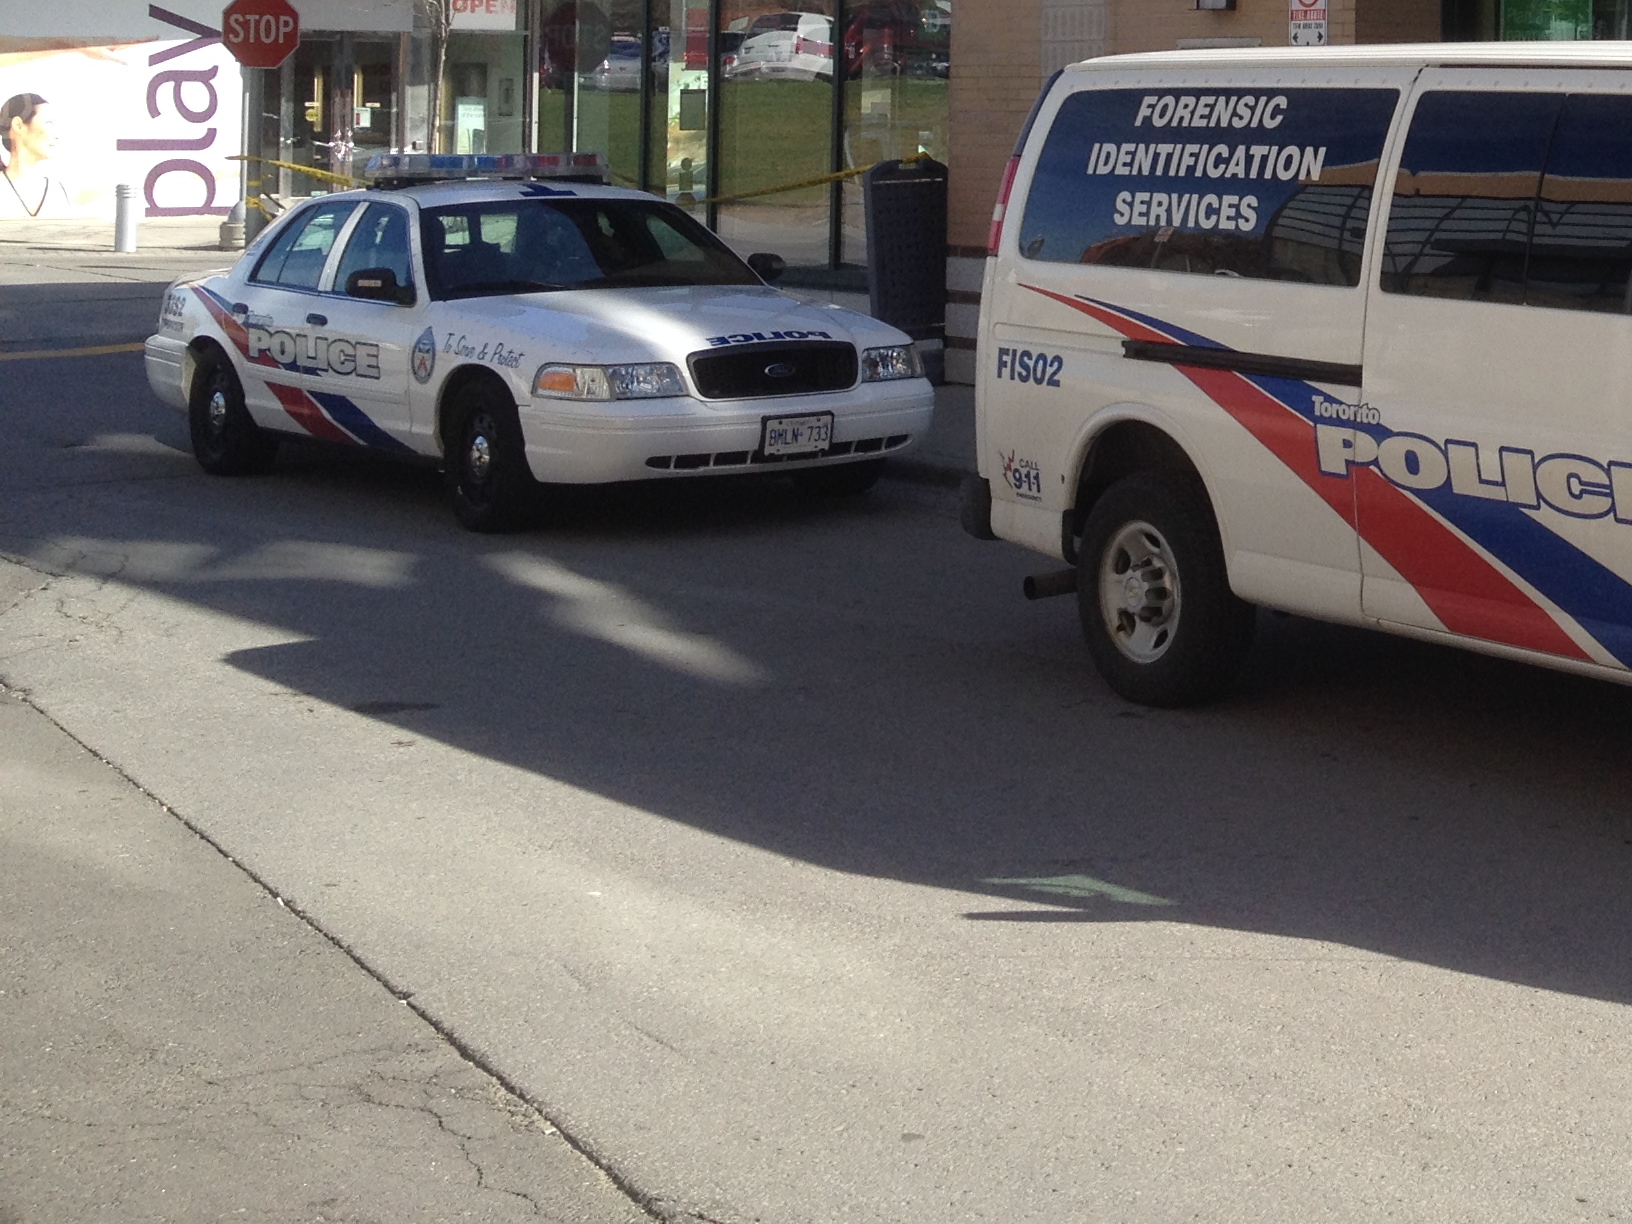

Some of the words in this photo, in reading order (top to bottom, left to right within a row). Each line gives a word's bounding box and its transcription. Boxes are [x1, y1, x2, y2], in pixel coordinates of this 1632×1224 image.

[228, 13, 295, 45] STOP
[1134, 94, 1288, 130] FORENSIC
[1086, 143, 1327, 182] IDENTIFICATION
[1112, 191, 1260, 232] SERVICES
[249, 326, 381, 380] POLICE
[997, 346, 1064, 388] FIS02
[1312, 394, 1381, 426] Toronto
[807, 423, 829, 442] 733
